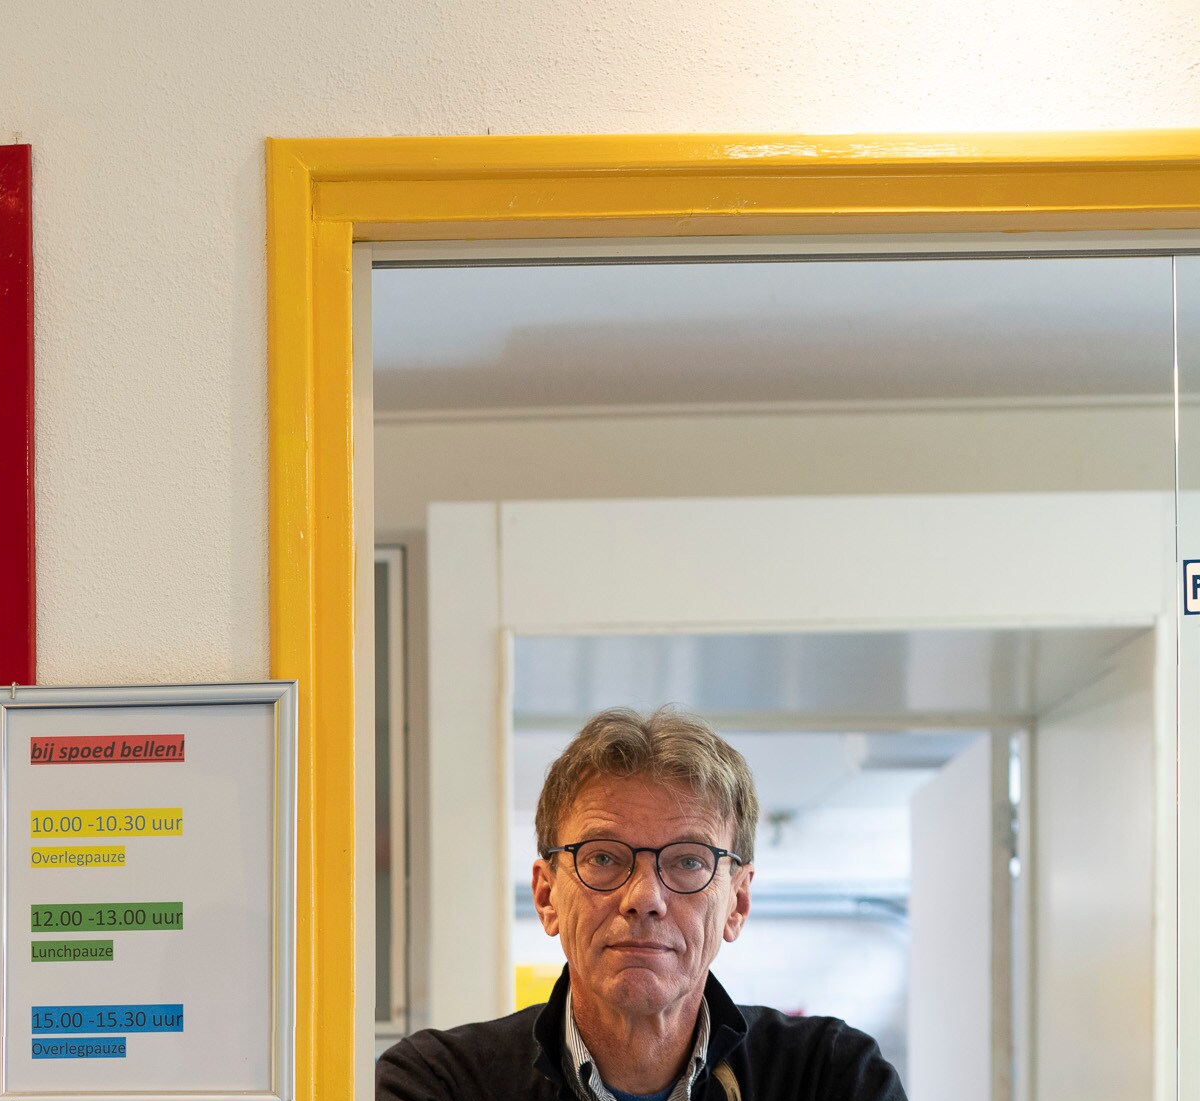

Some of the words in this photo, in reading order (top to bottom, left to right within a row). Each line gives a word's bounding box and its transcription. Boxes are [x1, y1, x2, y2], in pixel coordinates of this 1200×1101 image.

[31, 743, 54, 762] bij
[58, 741, 115, 762] spoed
[120, 740, 185, 760] bellen!
[32, 816, 82, 834] 10.00
[152, 815, 183, 832] uur
[31, 851, 126, 867] Overlegpauze
[32, 910, 82, 928] 12.00
[152, 910, 183, 926] uur
[32, 944, 113, 961] Lunchpauze
[32, 1011, 83, 1029] 15.00
[152, 1011, 183, 1027] uur
[32, 1041, 126, 1057] Overlegpauze
